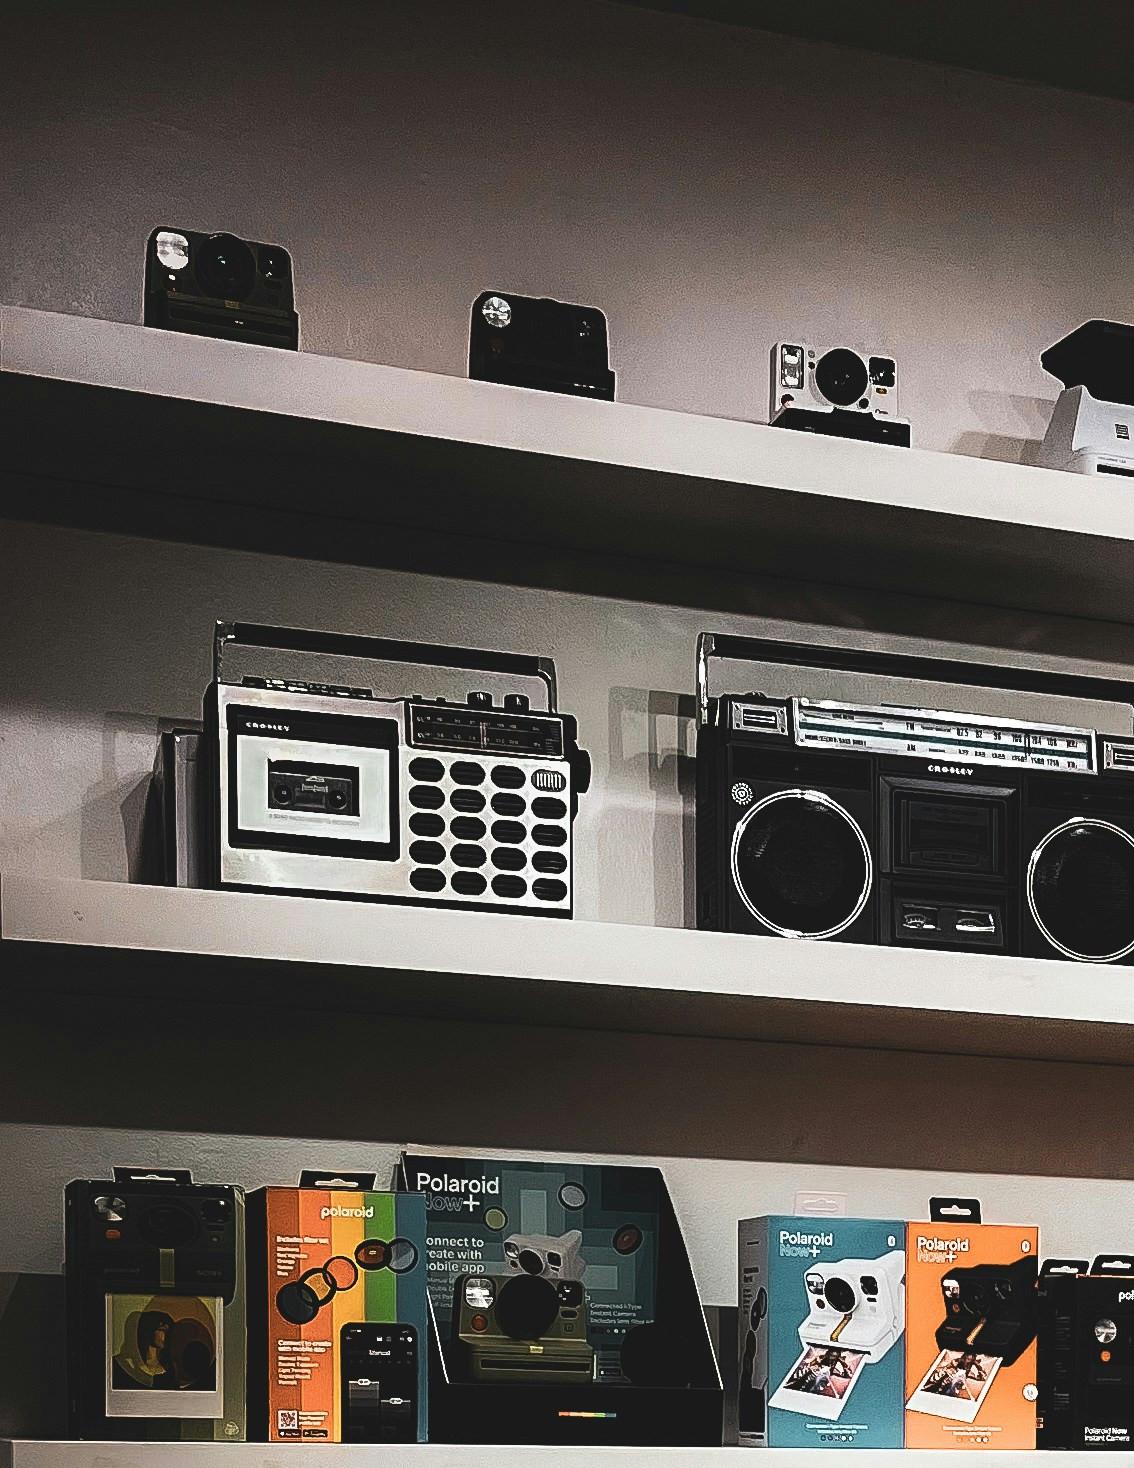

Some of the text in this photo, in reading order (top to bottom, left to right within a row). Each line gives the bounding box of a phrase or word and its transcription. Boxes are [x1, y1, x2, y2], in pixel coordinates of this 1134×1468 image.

[927, 764, 974, 776] CROSLEY
[417, 1172, 500, 1194] Polaroid
[321, 1206, 375, 1219] polaroid
[426, 1237, 485, 1248] onnect to
[779, 1230, 834, 1247] Polaroid
[917, 1236, 970, 1251] Polaroid
[457, 1249, 482, 1260] with
[779, 1244, 821, 1258] Now+
[917, 1249, 958, 1263] Now+
[426, 1262, 485, 1275] obile app
[1084, 1427, 1112, 1435] Polaroid
